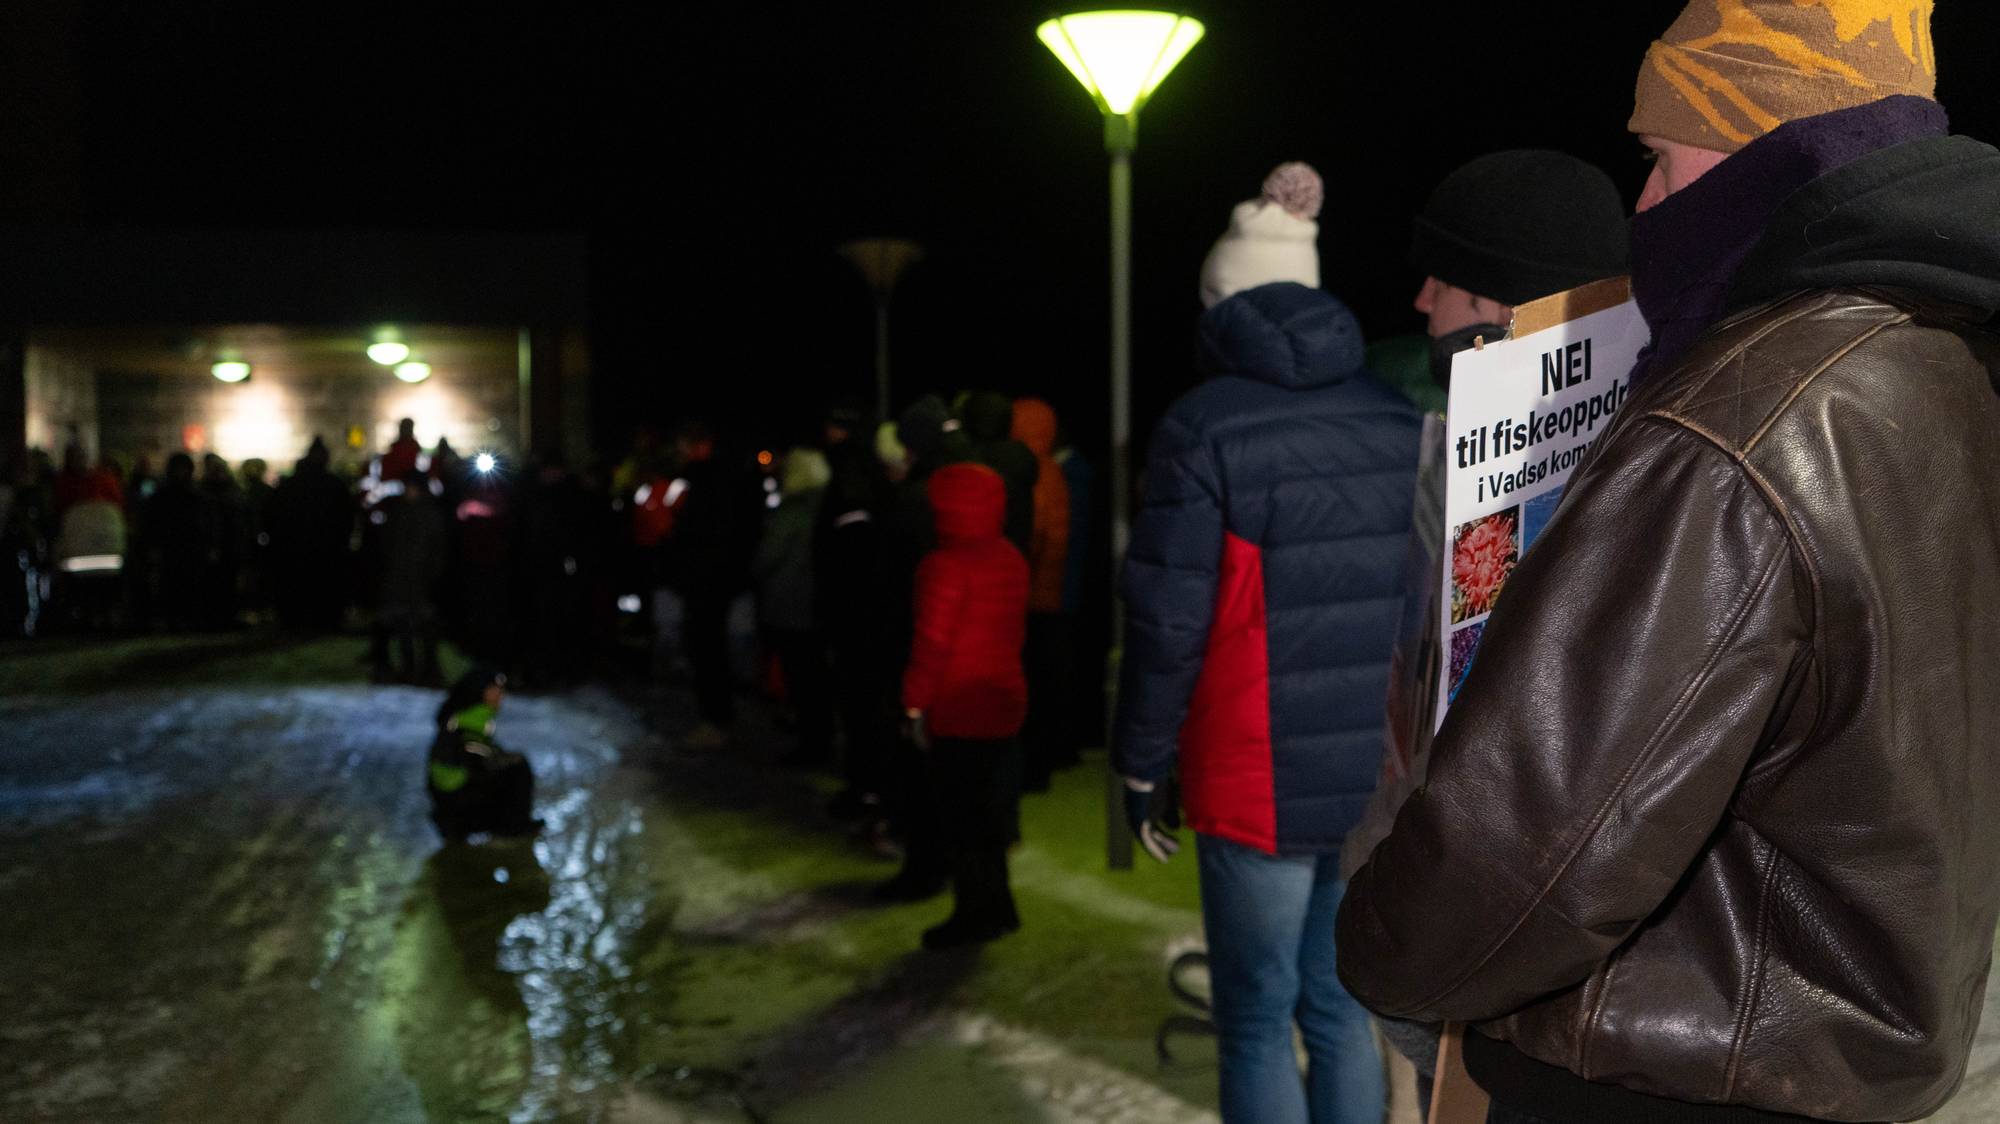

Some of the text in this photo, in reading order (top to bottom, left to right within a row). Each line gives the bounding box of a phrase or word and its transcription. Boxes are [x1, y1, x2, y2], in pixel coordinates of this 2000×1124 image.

[1541, 338, 1591, 396] NEI
[1456, 379, 1628, 469] til fiskeoppdr
[1478, 441, 1592, 503] i Vadsø kom
